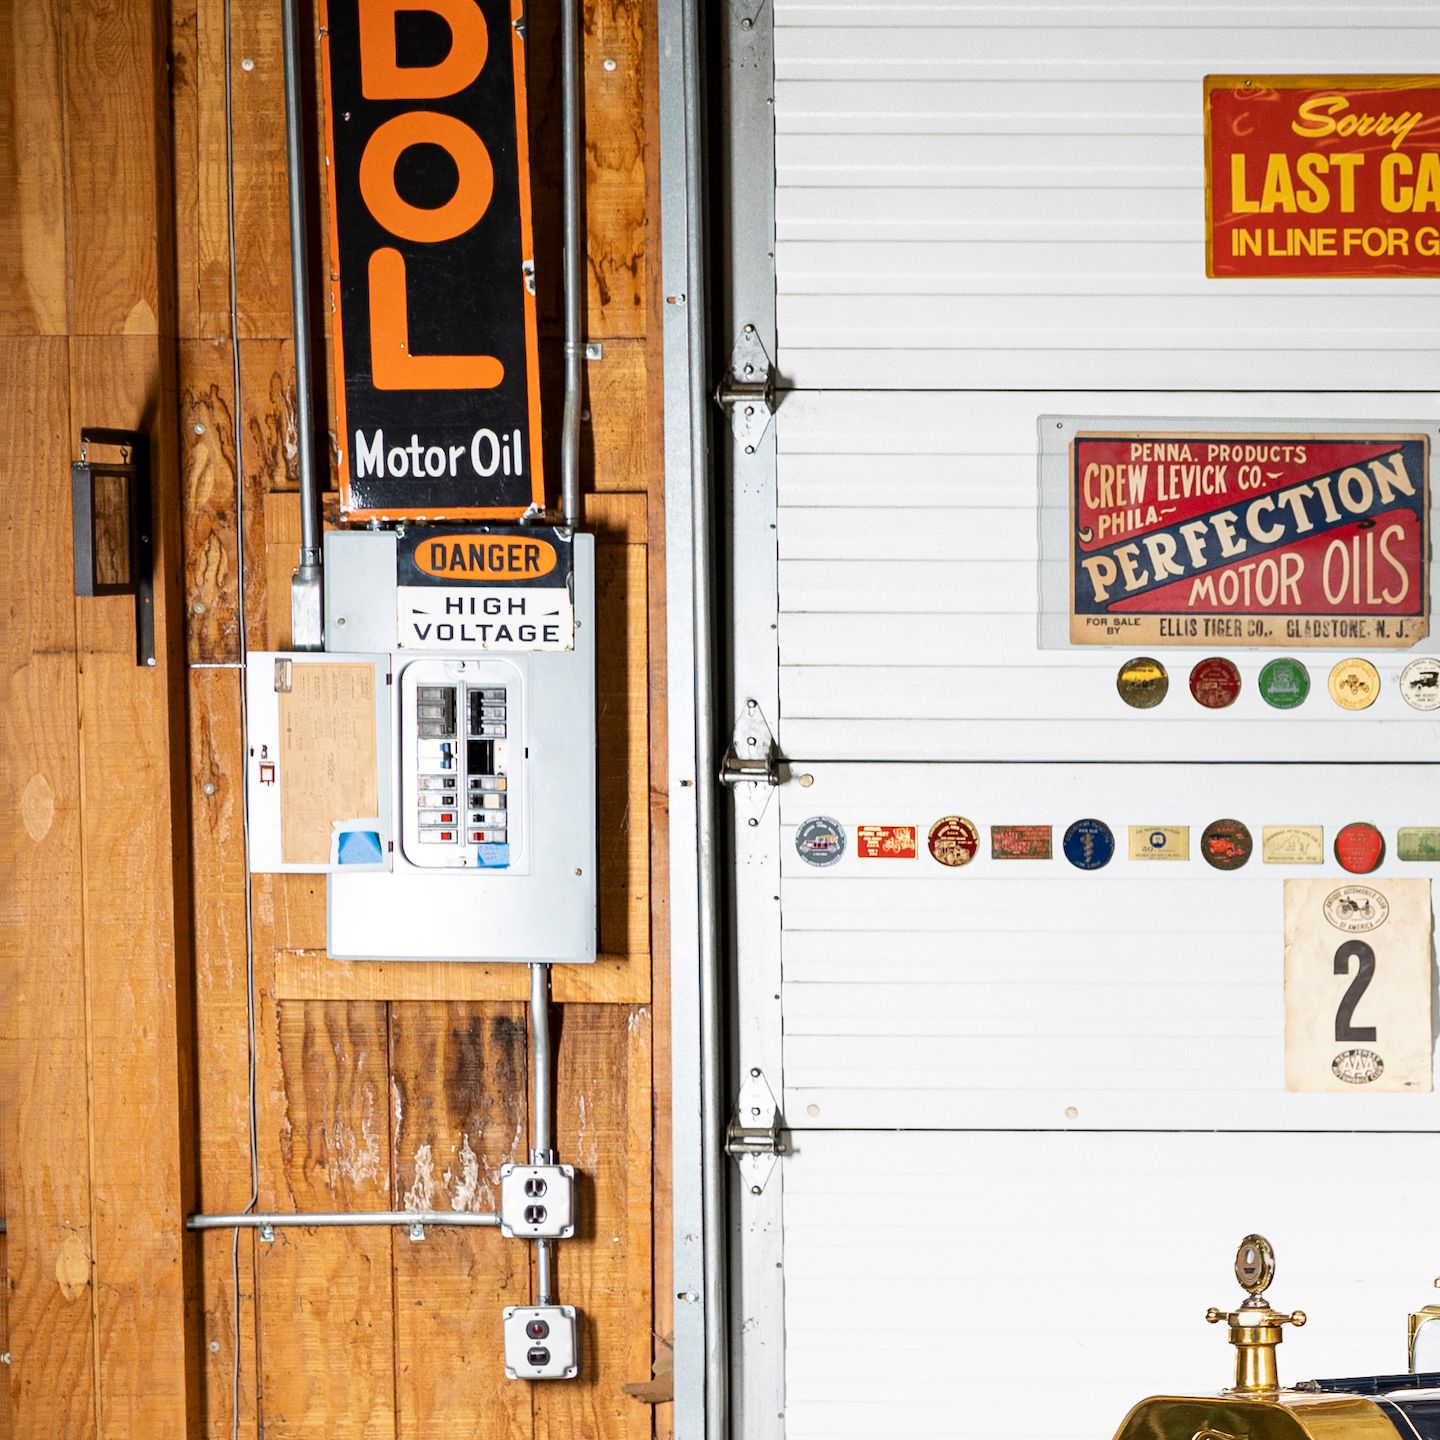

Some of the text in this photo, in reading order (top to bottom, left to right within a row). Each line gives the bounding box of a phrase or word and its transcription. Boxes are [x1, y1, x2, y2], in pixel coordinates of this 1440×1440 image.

[1291, 95, 1423, 151] Sorry
[1231, 153, 1365, 214] LAST
[1231, 228, 1262, 257] IN
[1268, 228, 1337, 257] LINE
[1343, 227, 1408, 257] FOR
[355, 427, 523, 478] Motor Oil
[1130, 442, 1307, 465] PENNA. PRODUCTS
[1083, 462, 1267, 510] CREW LEVICK CO.
[1081, 452, 1416, 603] PERFECTION
[1097, 507, 1163, 540] PHILA.
[430, 543, 540, 573] DANGER
[1187, 523, 1410, 607] MOTOR OILS
[445, 597, 526, 616] HIGH
[1086, 617, 1141, 627] FOR SALE
[413, 623, 560, 643] VOLTAGE
[1106, 626, 1121, 635] BY
[1159, 617, 1198, 638] ELLIS
[1203, 617, 1243, 638] TIGER
[1333, 939, 1377, 1042] 2
